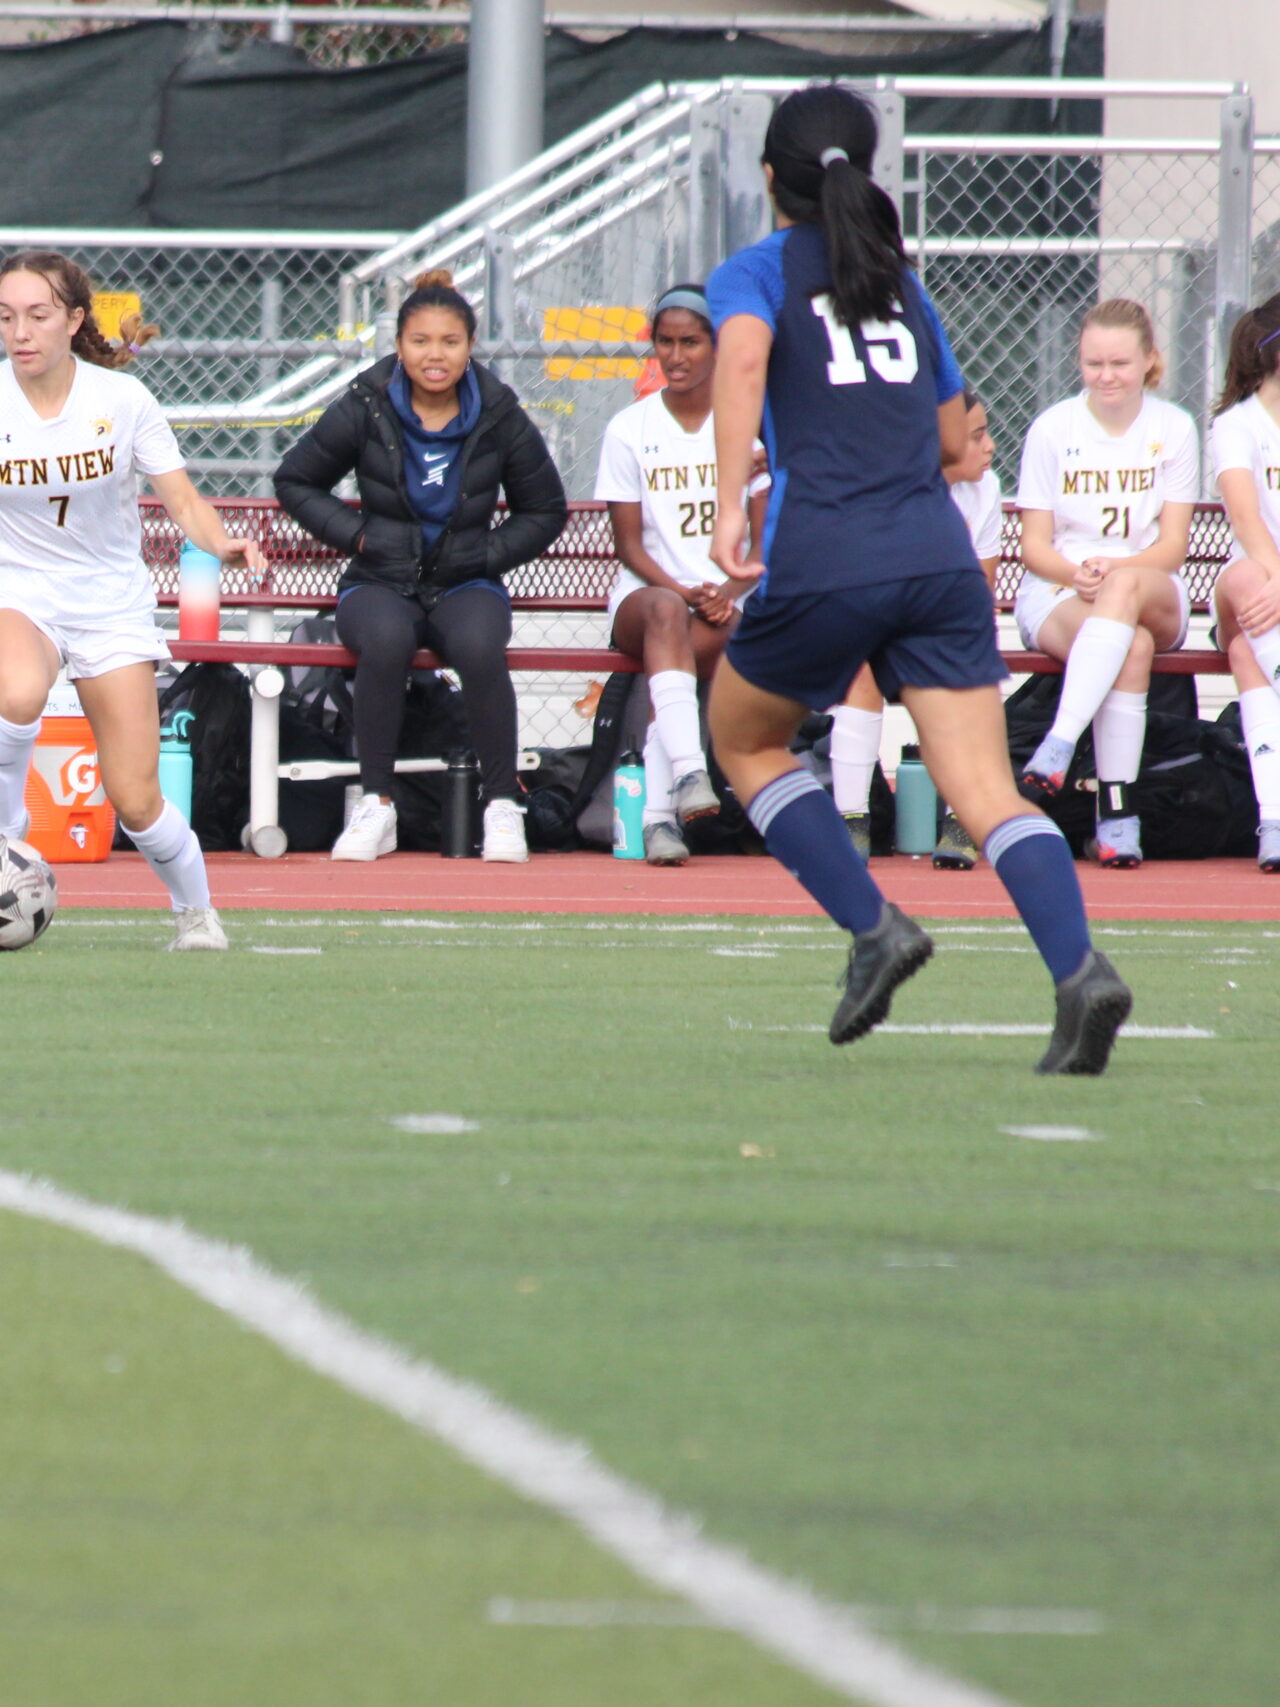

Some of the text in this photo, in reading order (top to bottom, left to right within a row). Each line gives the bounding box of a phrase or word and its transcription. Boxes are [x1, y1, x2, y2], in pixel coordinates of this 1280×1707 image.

[810, 292, 919, 386] 15
[55, 444, 116, 484] VIEW
[695, 462, 717, 489] VI
[1062, 469, 1110, 495] MTN
[48, 495, 70, 528] 7
[678, 500, 716, 539] 28
[1101, 505, 1130, 540] 21
[67, 753, 97, 794] G
